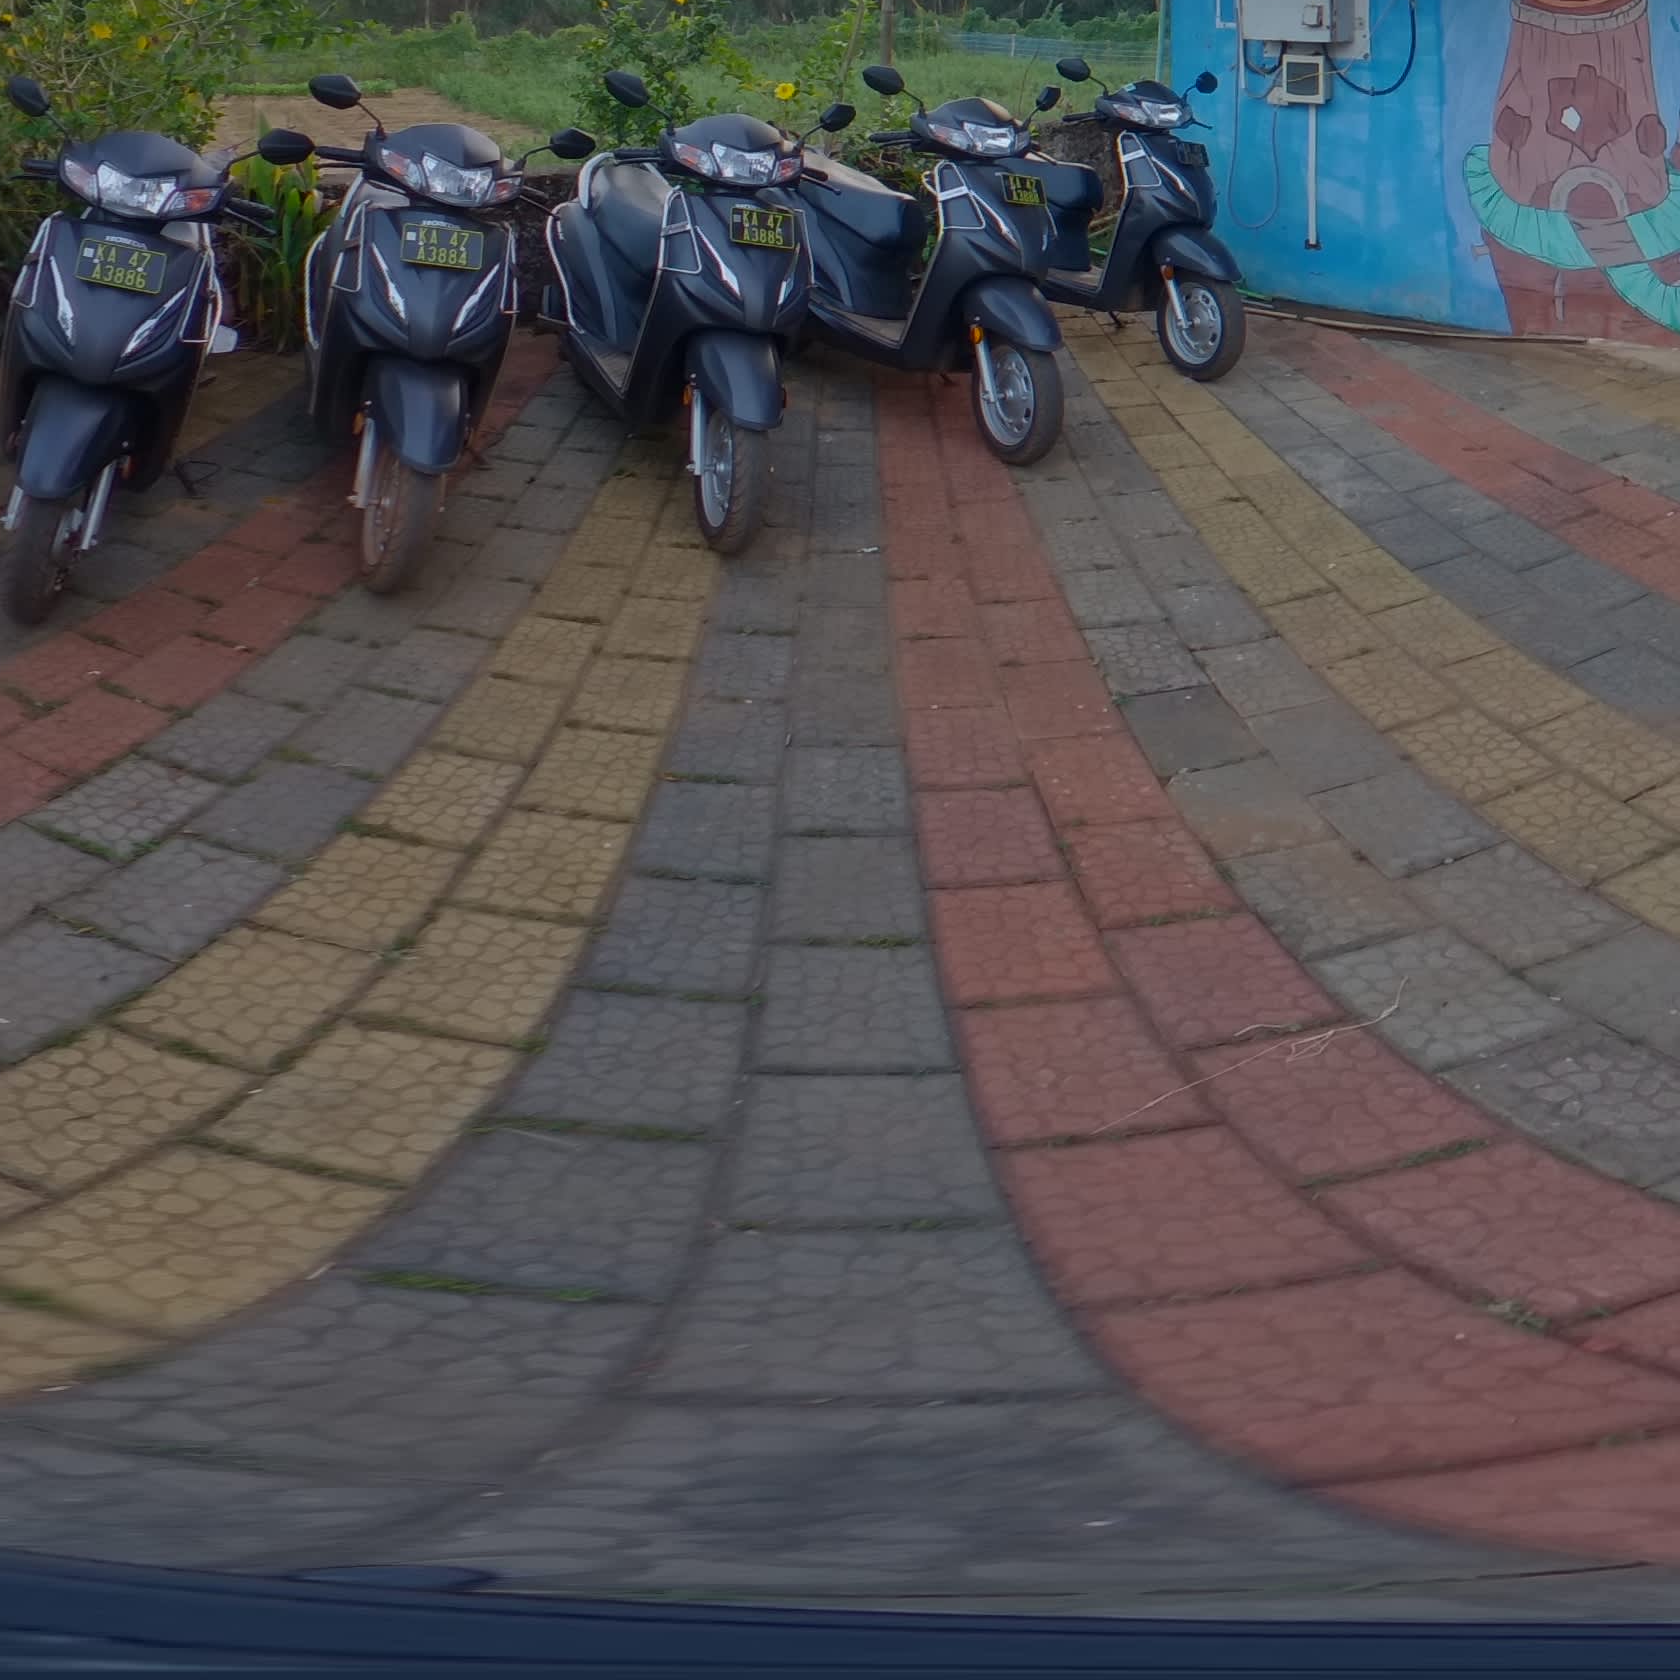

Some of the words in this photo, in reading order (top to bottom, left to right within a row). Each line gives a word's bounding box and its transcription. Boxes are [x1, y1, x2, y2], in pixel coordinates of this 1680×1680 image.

[419, 228, 438, 244] KA
[449, 231, 470, 248] 47
[96, 244, 117, 263] KA
[128, 251, 152, 268] 47
[91, 263, 148, 289] A3886
